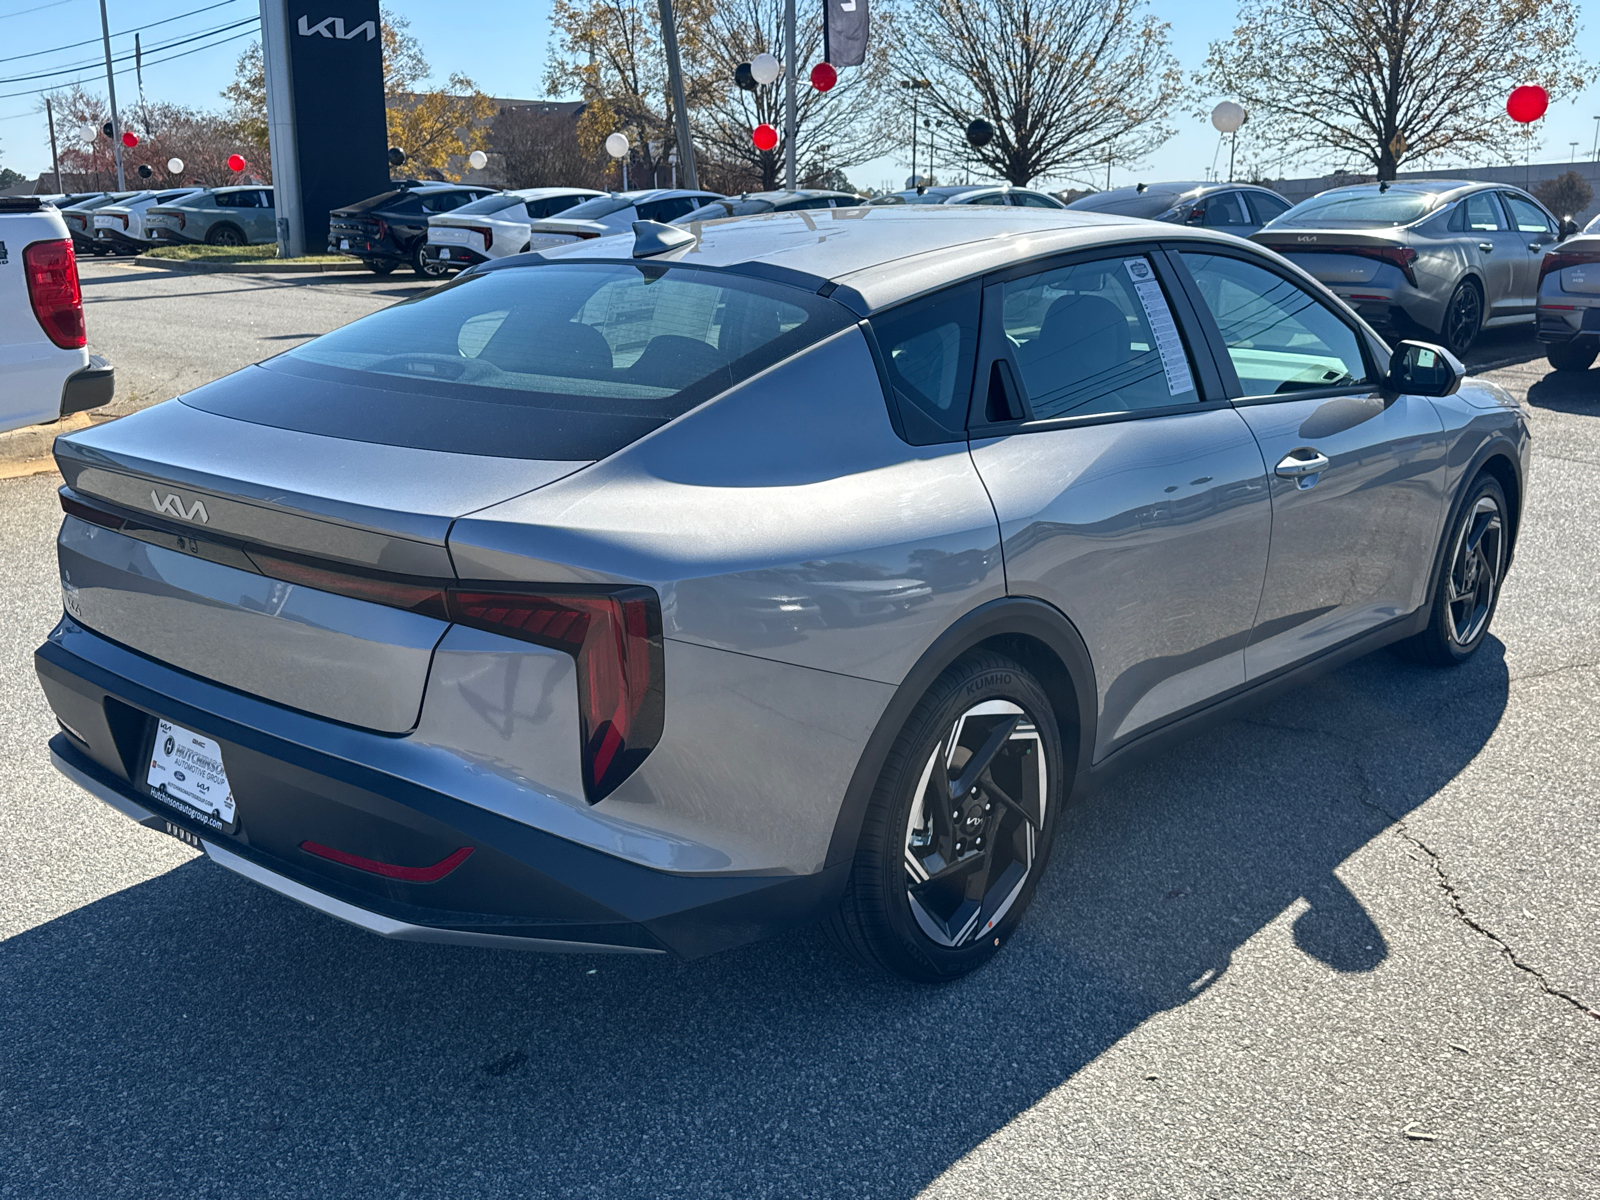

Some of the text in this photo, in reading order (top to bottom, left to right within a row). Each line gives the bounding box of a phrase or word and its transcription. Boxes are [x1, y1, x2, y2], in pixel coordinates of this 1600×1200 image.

[298, 14, 376, 42] KIA
[150, 489, 210, 524] KIA
[966, 674, 1012, 696] KUMHO
[160, 722, 172, 731] KIA
[191, 738, 206, 748] GMC
[174, 758, 226, 786] AUTOMOTIVE GROUP
[196, 781, 210, 792] KIA
[150, 787, 223, 830] Hutchinsonautogroup.com
